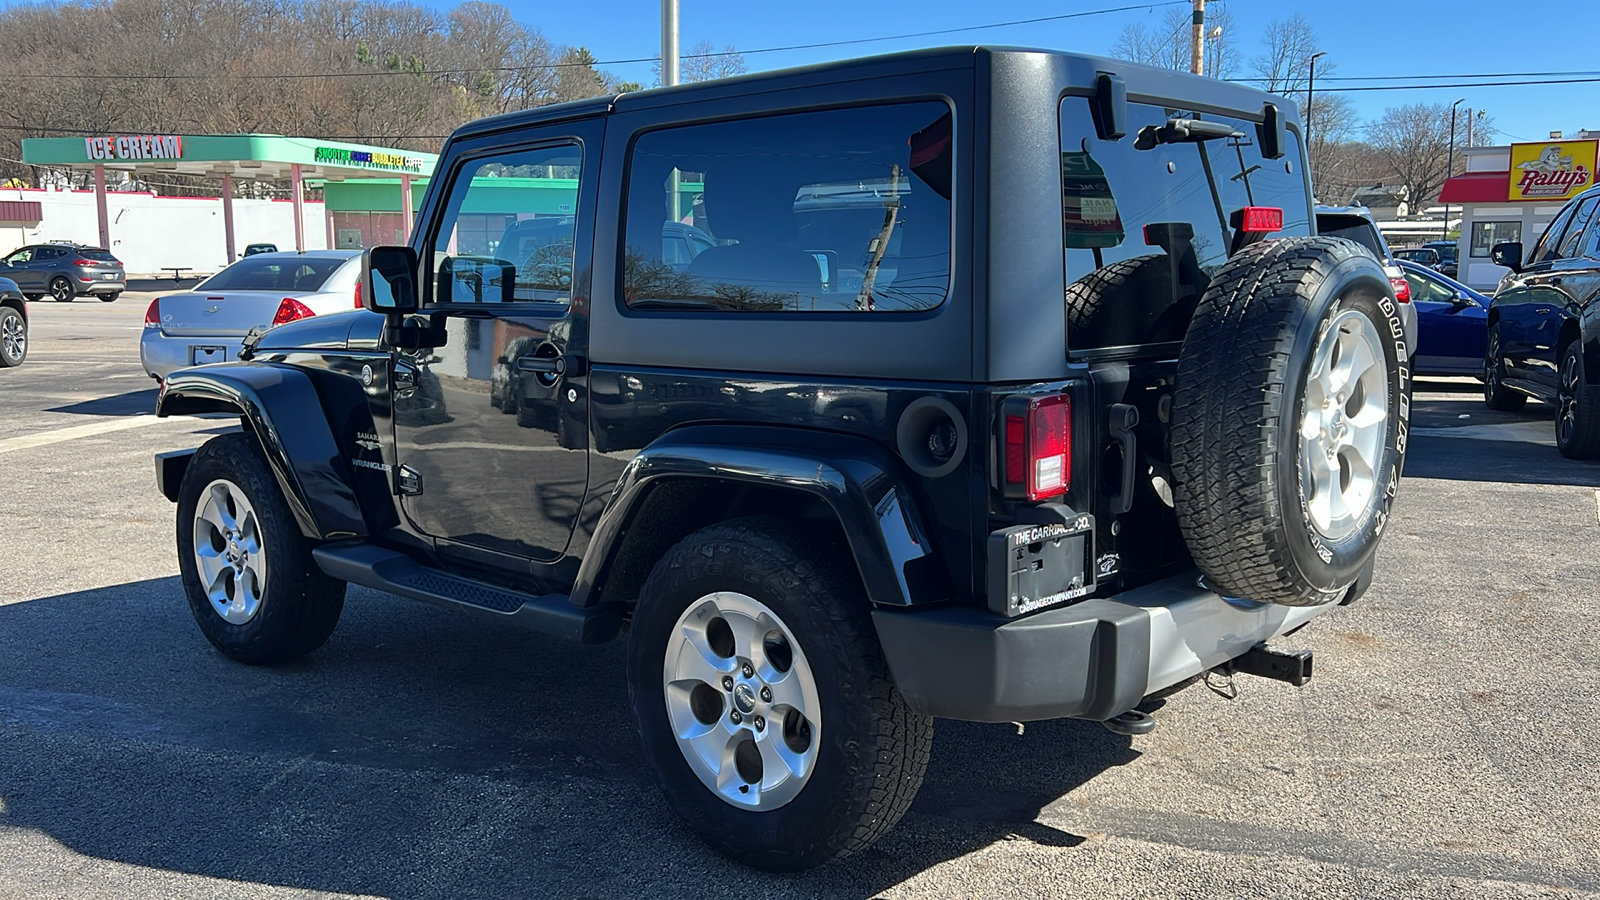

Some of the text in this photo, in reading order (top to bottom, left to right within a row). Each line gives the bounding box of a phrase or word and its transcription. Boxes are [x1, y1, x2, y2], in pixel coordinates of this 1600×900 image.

[85, 134, 182, 160] ICE CREAM
[1517, 165, 1588, 195] Rally's
[357, 431, 383, 441] SAHARA
[352, 458, 392, 473] WRANGLER
[1014, 529, 1031, 545] THE
[1018, 586, 1087, 614] CARRIAGECOMPANY.COM
